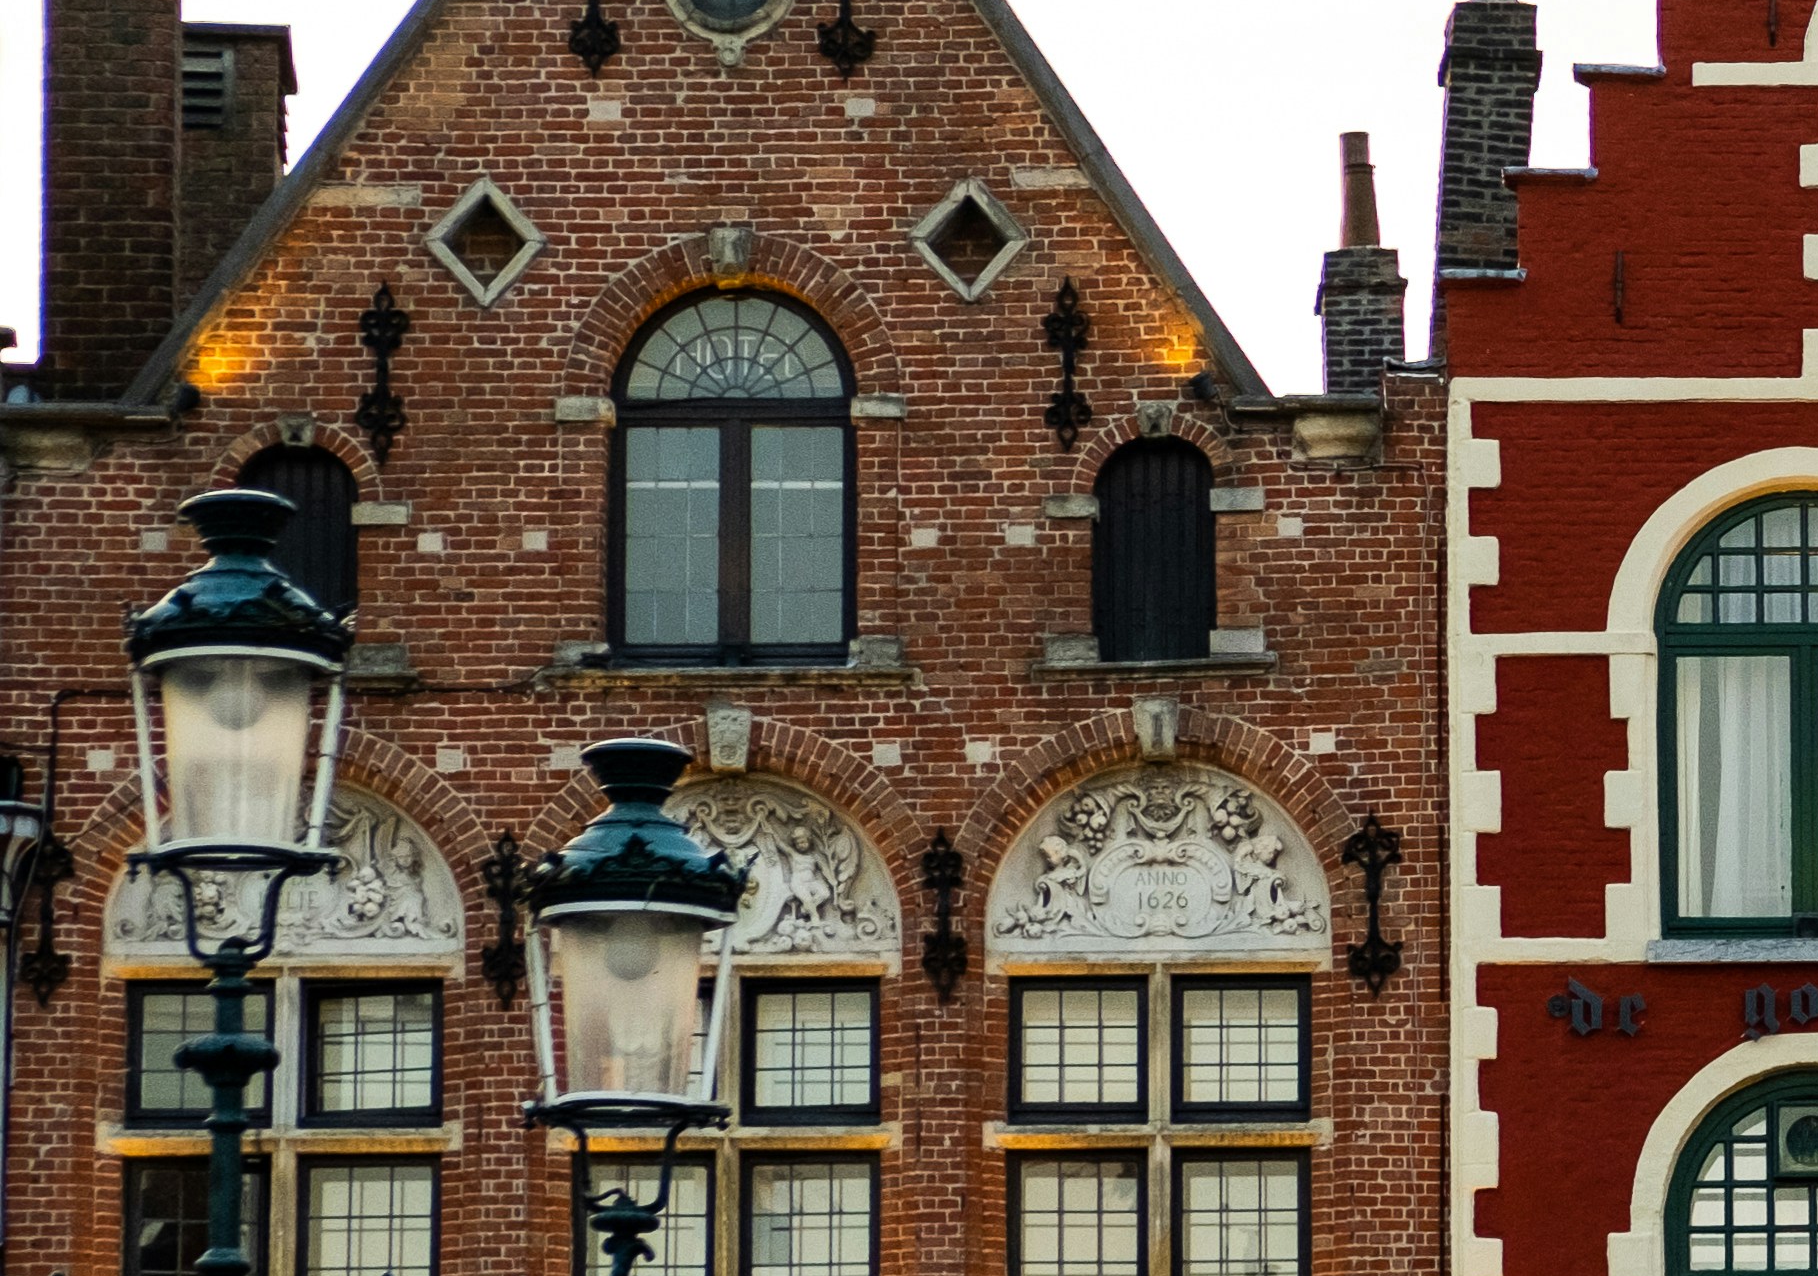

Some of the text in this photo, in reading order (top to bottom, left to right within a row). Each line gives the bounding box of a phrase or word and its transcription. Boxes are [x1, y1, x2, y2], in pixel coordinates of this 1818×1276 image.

[1134, 871, 1188, 886] ANNO
[1138, 890, 1189, 910] 1626
[1568, 977, 1647, 1037] de
